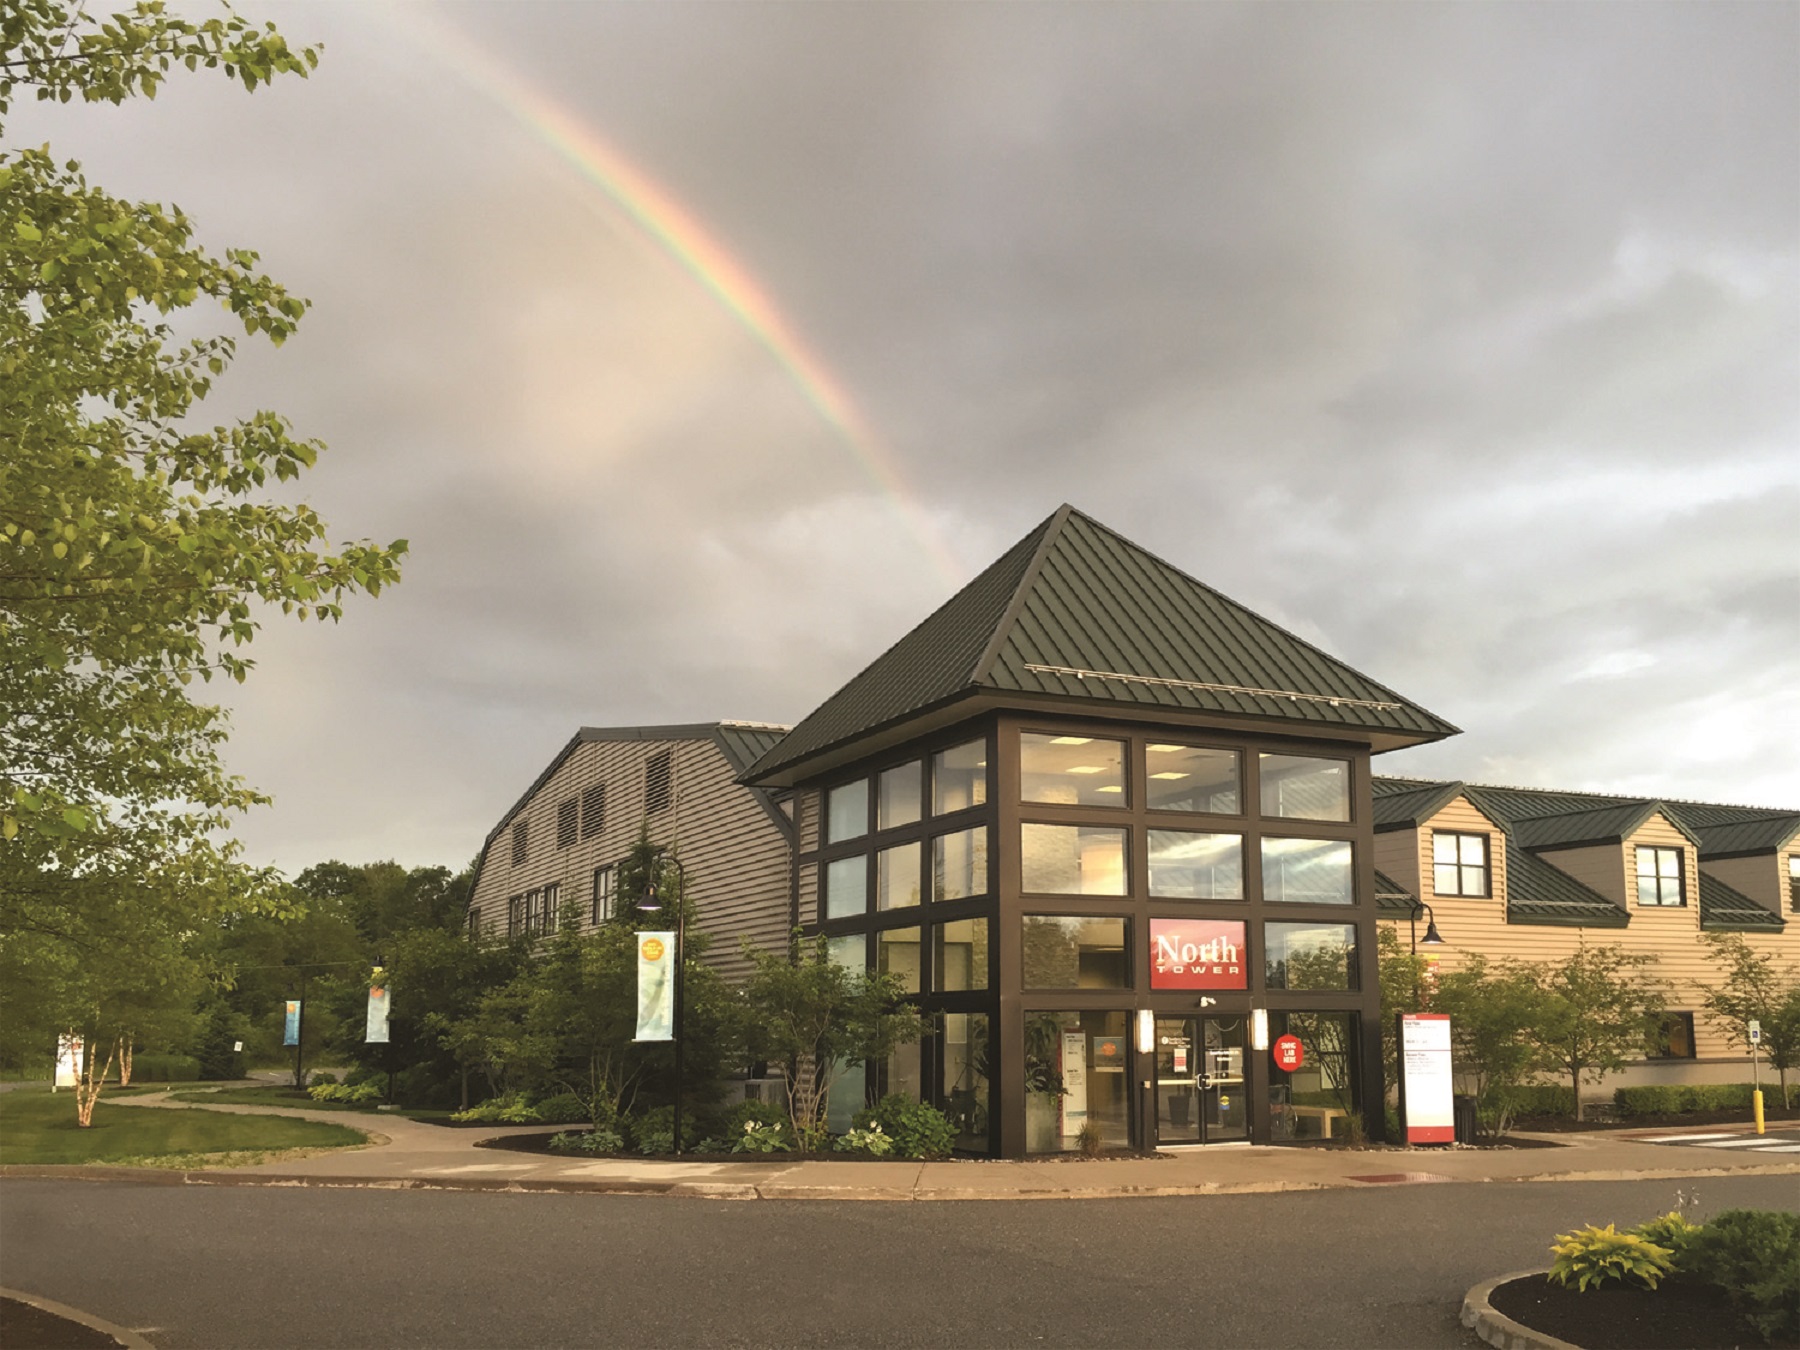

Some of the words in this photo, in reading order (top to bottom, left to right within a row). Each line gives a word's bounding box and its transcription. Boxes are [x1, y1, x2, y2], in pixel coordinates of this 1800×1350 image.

[1156, 934, 1239, 963] North
[1156, 965, 1239, 974] TOWER
[1283, 1056, 1297, 1064] HERE
